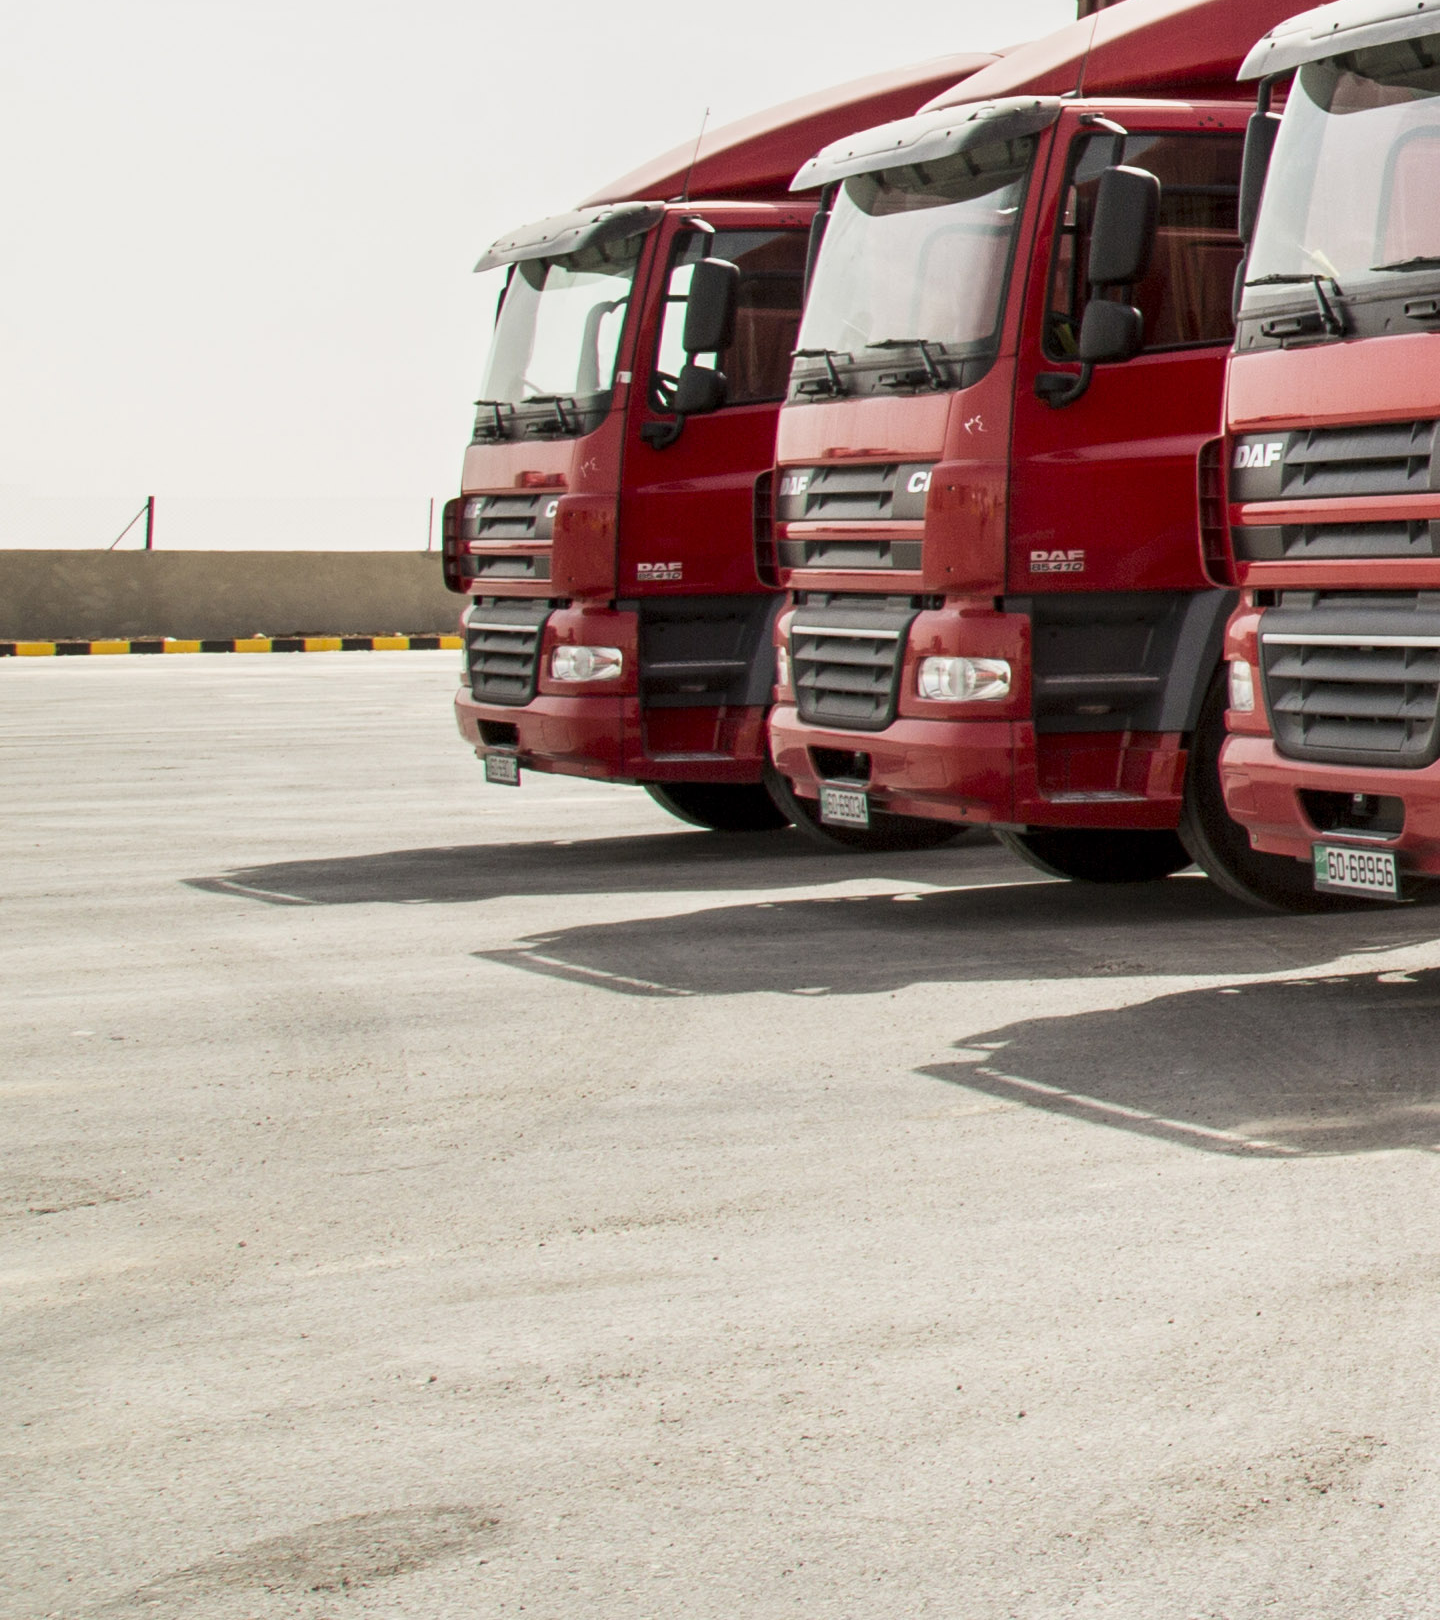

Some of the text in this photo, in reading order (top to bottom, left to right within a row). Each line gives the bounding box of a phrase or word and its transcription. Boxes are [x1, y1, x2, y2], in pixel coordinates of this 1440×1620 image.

[1233, 442, 1283, 468] DAF
[1031, 550, 1084, 561] DAF
[638, 562, 682, 571] DAF
[1328, 851, 1394, 887] 60-68956
